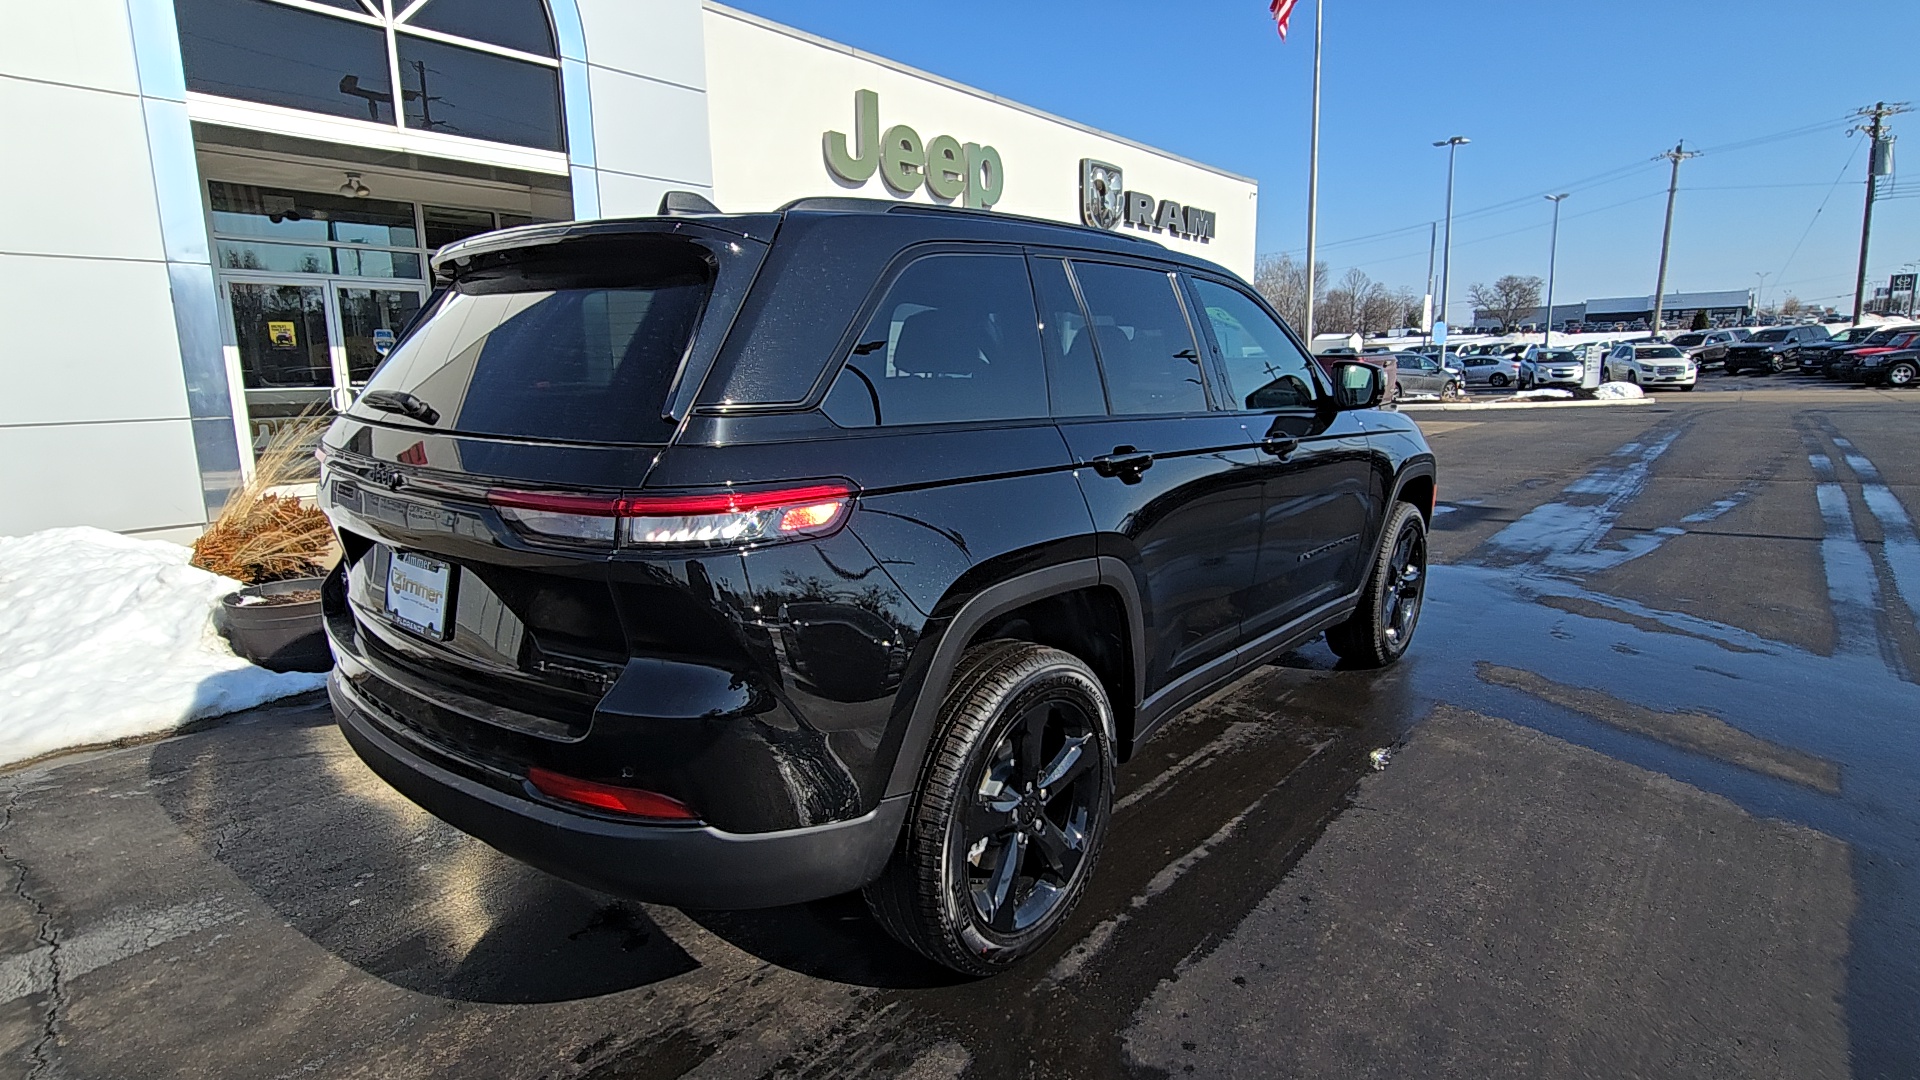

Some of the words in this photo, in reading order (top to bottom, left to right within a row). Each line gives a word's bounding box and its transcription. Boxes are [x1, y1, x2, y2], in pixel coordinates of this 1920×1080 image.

[823, 89, 1003, 208] Jeep
[1124, 190, 1216, 239] RAM
[402, 552, 432, 570] Zimmer
[391, 567, 443, 604] Zimmer
